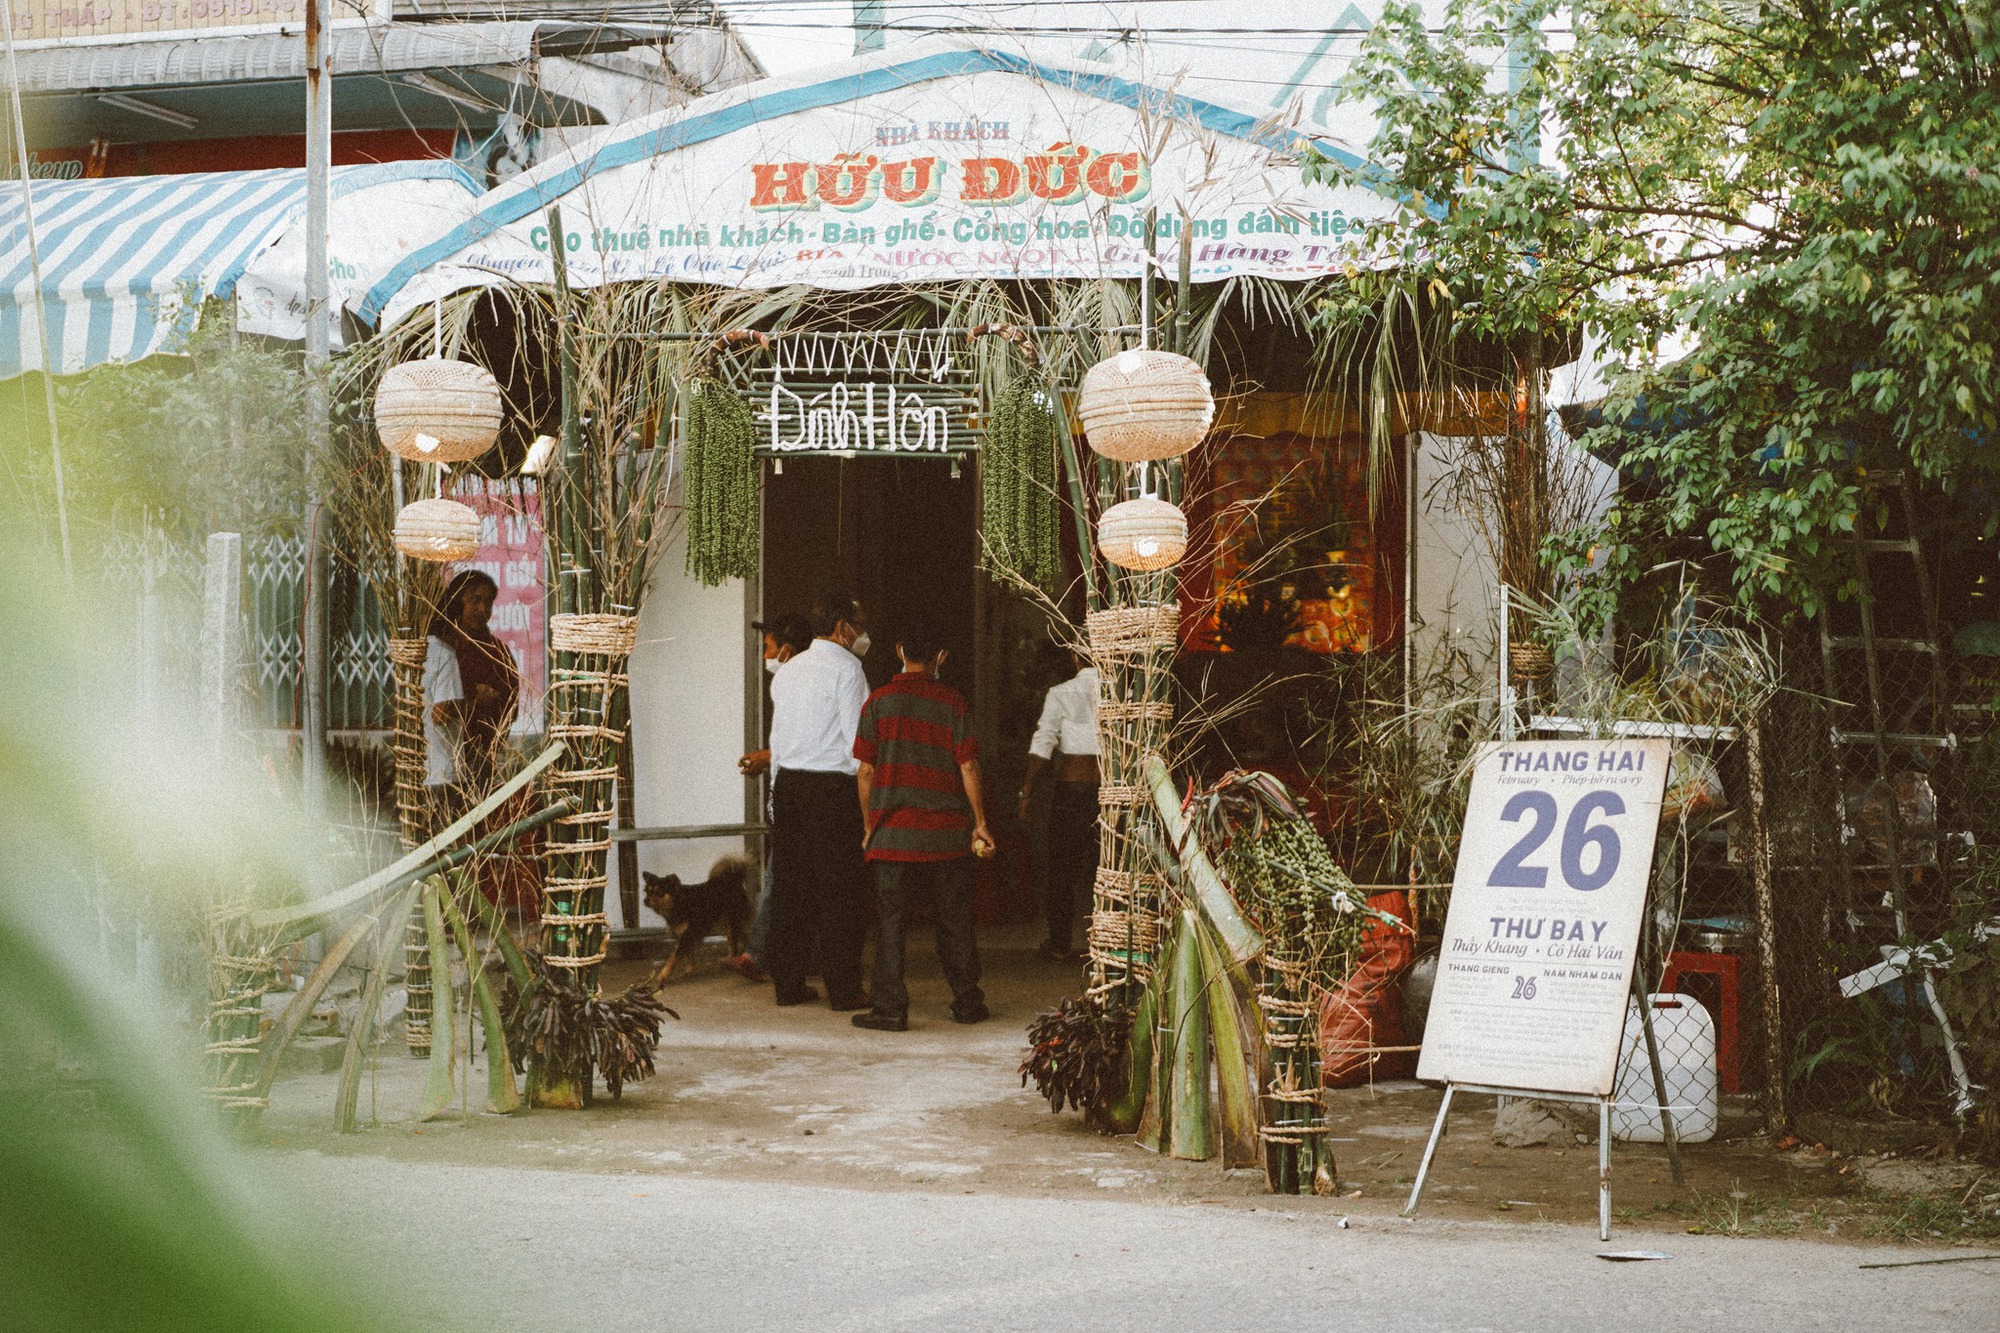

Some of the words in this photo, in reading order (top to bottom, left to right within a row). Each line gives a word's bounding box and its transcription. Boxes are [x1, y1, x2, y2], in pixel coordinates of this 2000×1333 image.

[750, 151, 947, 213] HỮU
[959, 140, 1153, 208] ĐỨC
[530, 225, 582, 252] Co
[590, 224, 652, 252] thuê
[823, 219, 877, 245] Bàn
[1237, 208, 1300, 236] đám
[1197, 242, 1293, 266] Hàng
[1596, 750, 1646, 772] HAI
[1486, 789, 1627, 892] 26
[1484, 940, 1529, 959] Khang
[1547, 943, 1568, 958] Cô
[1597, 944, 1624, 961] Vân
[1511, 975, 1538, 1001] 26
